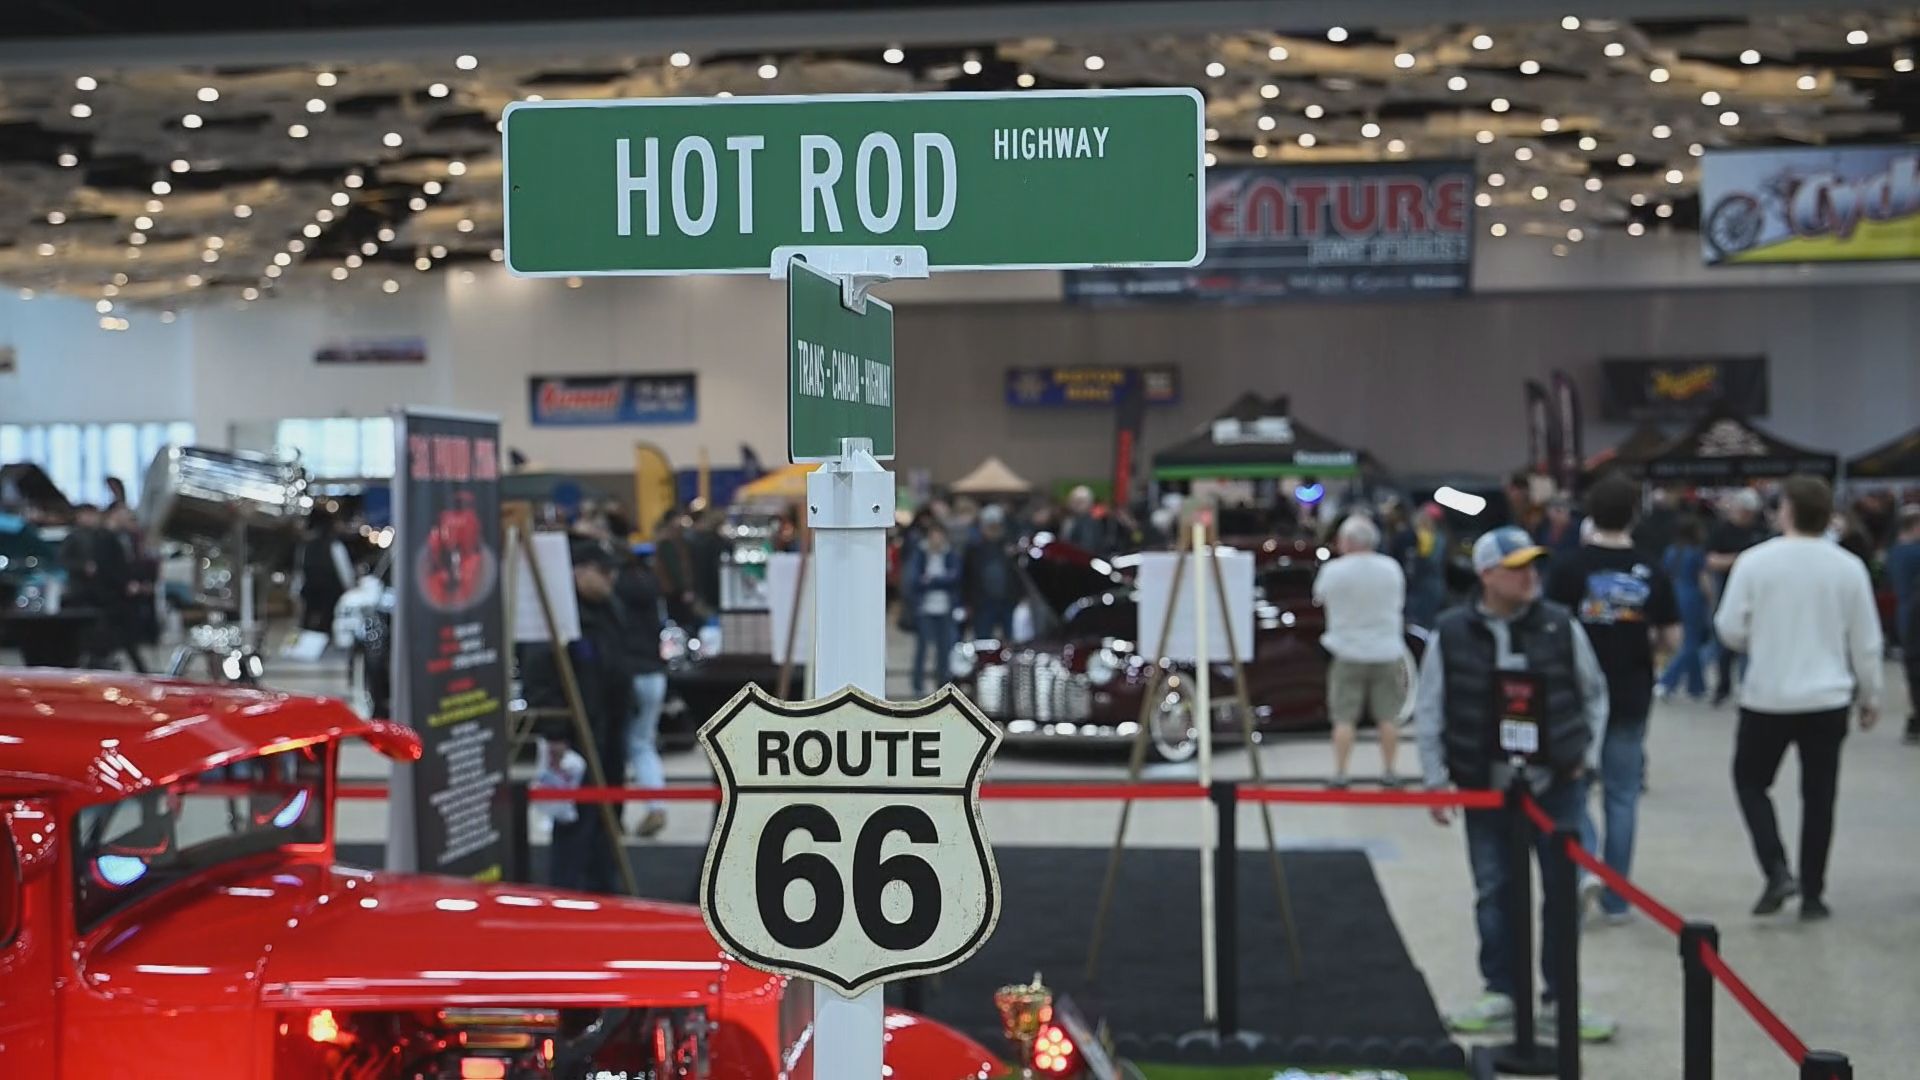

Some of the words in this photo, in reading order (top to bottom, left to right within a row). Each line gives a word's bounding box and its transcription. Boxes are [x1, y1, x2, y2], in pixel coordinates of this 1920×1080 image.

[994, 127, 1110, 160] HIGHWAY
[616, 135, 765, 236] HOT
[800, 131, 958, 234] ROD
[798, 339, 825, 398] TRANS
[832, 349, 860, 403] CANADA
[864, 358, 891, 408] HIGHWAY
[758, 730, 941, 777] ROUTE
[755, 803, 942, 950] 66
